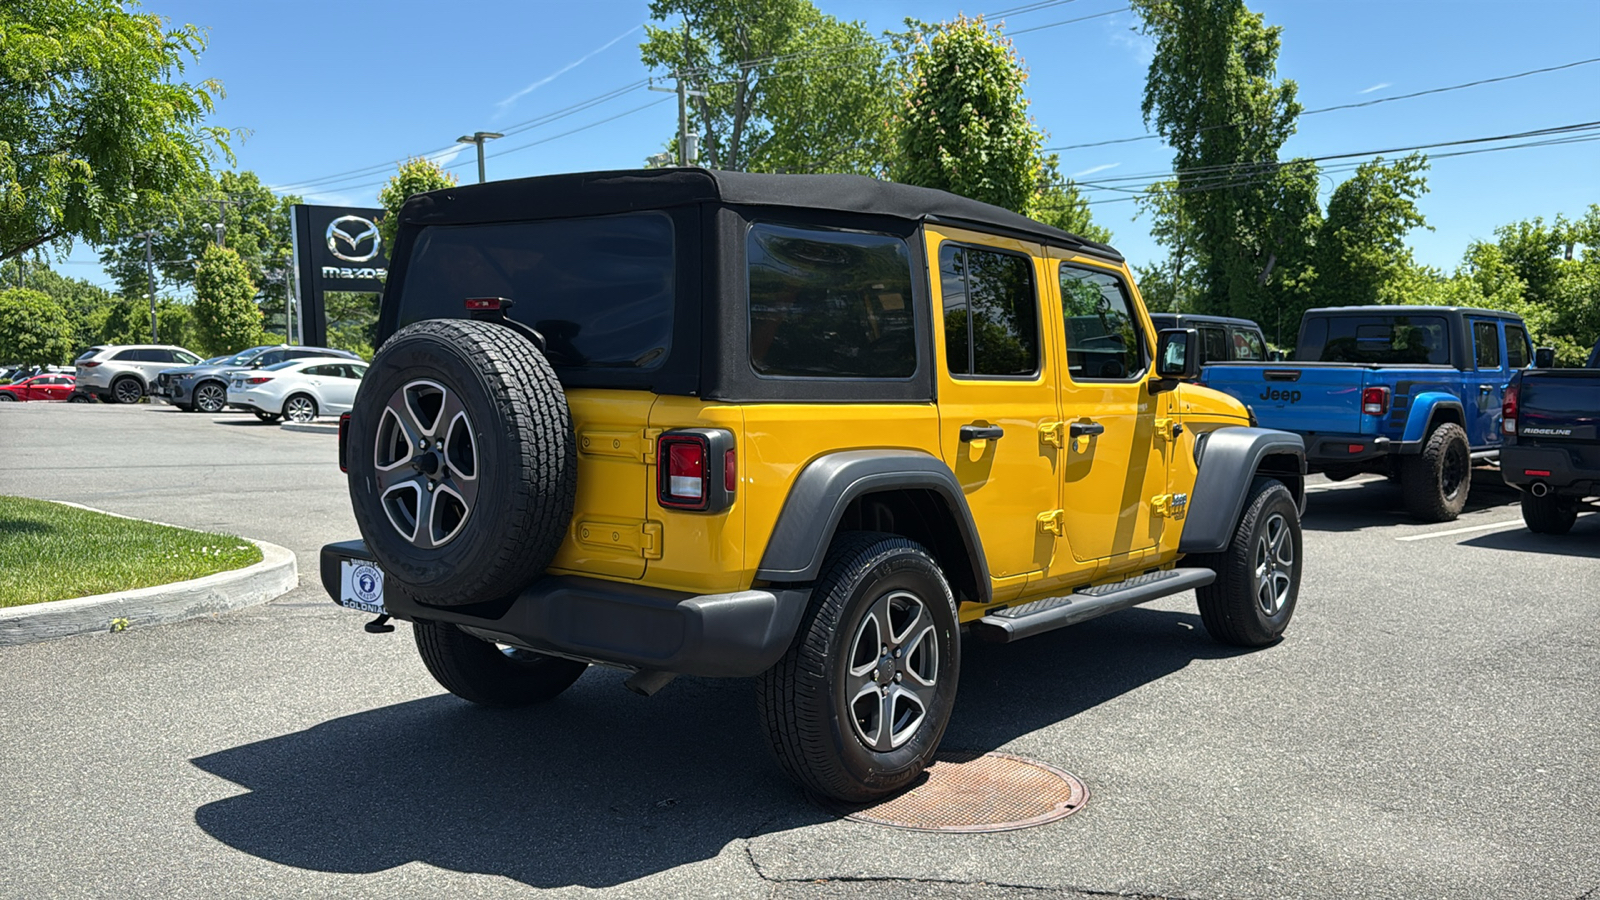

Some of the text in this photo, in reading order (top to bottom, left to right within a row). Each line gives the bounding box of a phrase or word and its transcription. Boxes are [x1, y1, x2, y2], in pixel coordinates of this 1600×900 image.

[1260, 386, 1302, 404] Jeep
[1523, 427, 1572, 436] RIDGELINE
[355, 567, 380, 583] COLONIAL
[342, 600, 389, 615] COLONIAL
